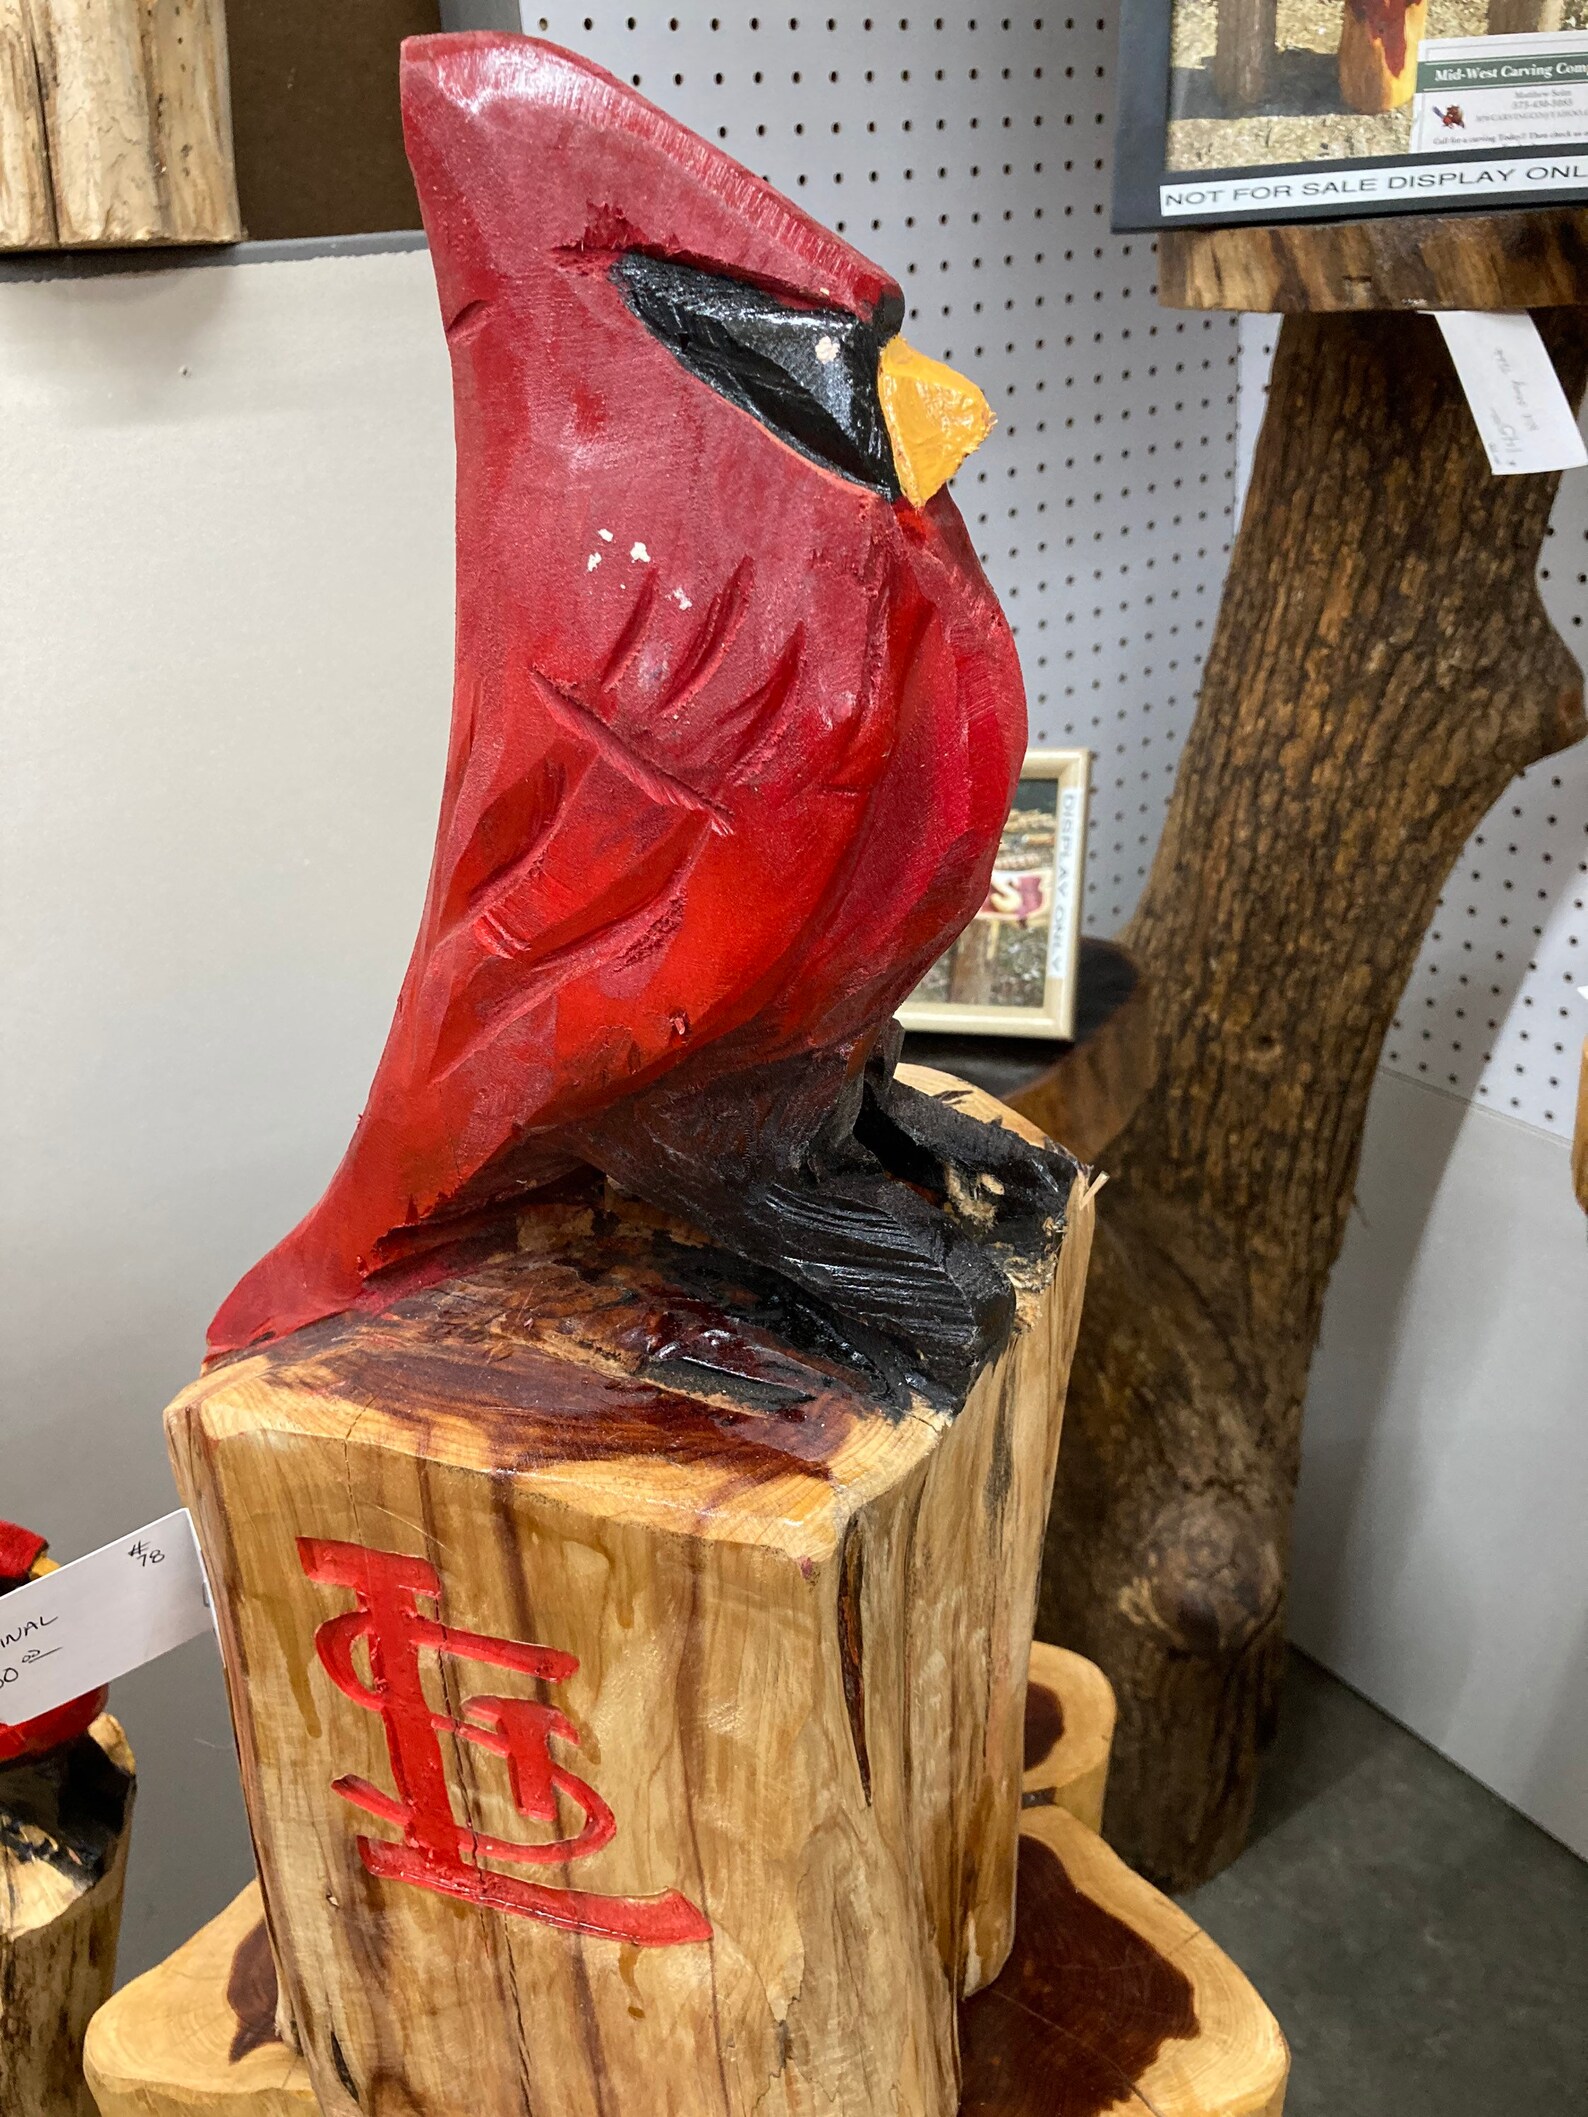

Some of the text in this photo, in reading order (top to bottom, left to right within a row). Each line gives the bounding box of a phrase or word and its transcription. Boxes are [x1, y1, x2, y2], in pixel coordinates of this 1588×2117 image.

[1434, 67, 1498, 82] Mid-West
[1500, 63, 1553, 79] Carving
[1165, 165, 1588, 206] NOT FOR SALE DISPLAY ONL
[1051, 793, 1076, 972] DISPLAY ONLY
